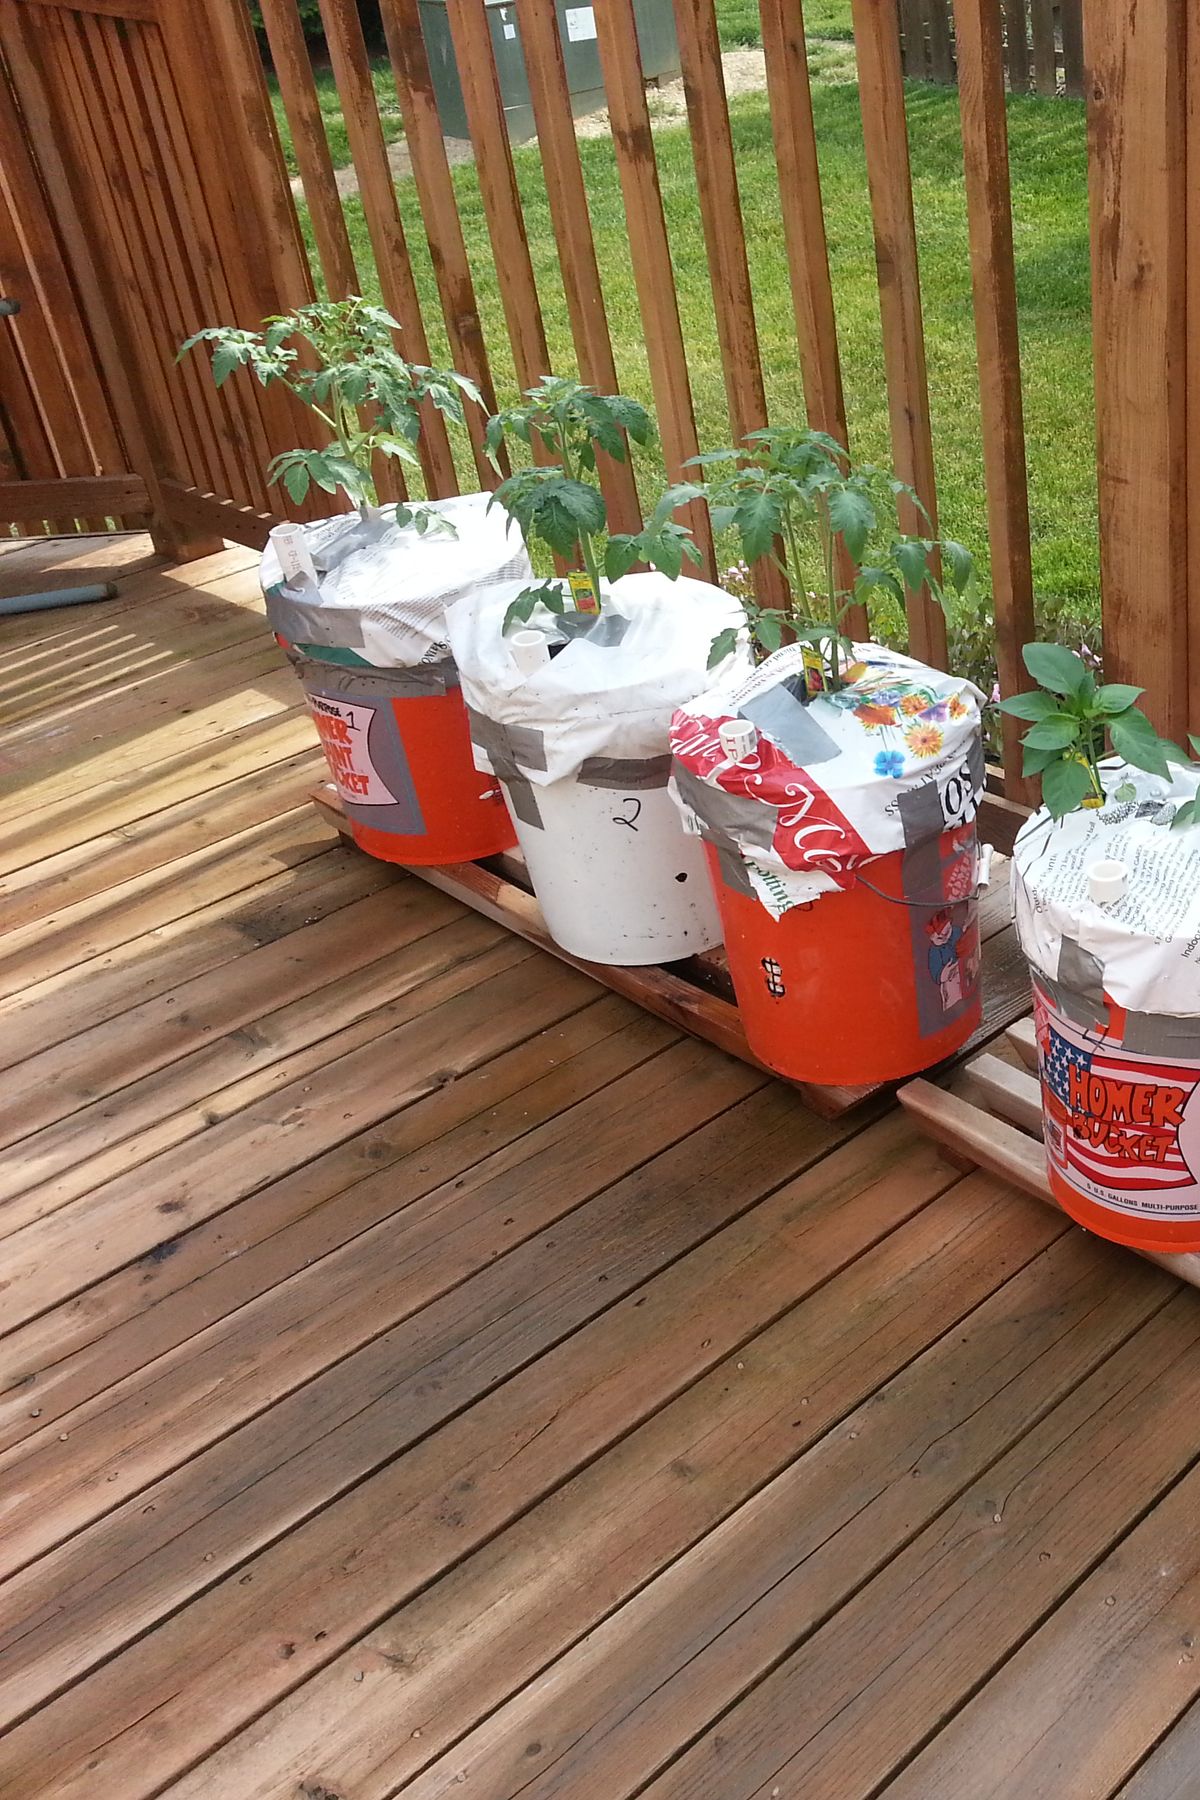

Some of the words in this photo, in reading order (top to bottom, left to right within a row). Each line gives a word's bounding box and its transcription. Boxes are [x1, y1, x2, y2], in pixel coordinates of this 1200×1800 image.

[346, 711, 360, 731] 1
[612, 798, 641, 832] 2
[1068, 1063, 1185, 1127] HOMER
[1072, 1113, 1178, 1163] BUCKET
[1108, 1193, 1138, 1207] GALLONS
[1141, 1201, 1198, 1211] MULTI-PURPOSE
